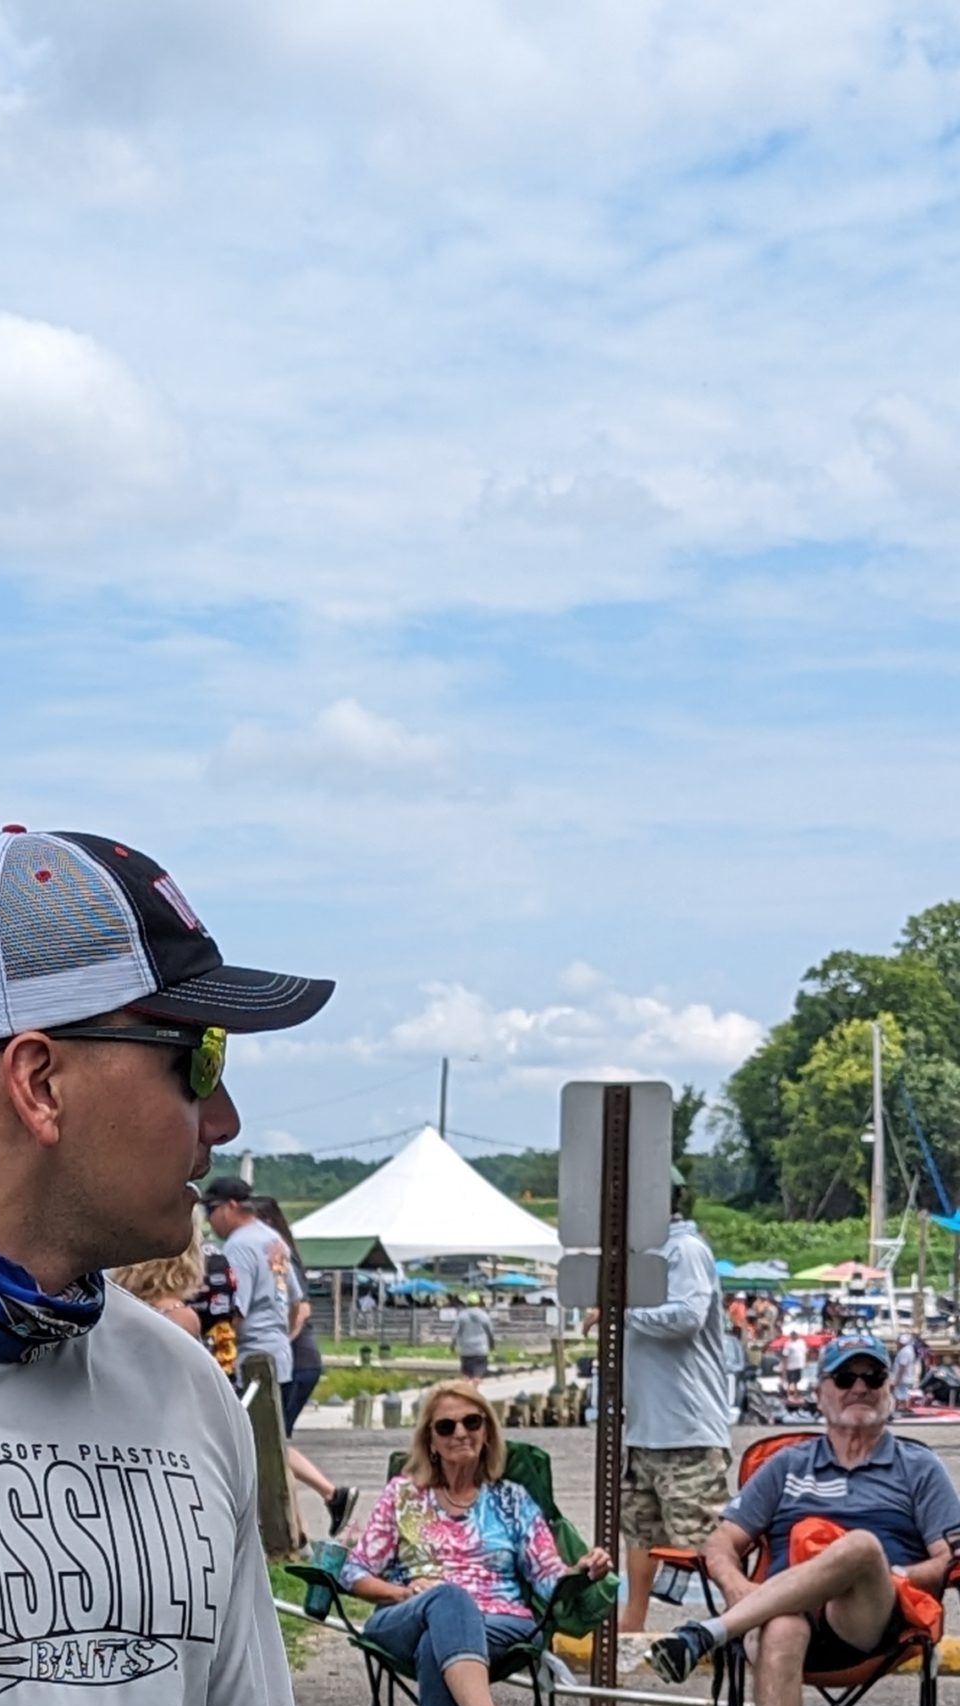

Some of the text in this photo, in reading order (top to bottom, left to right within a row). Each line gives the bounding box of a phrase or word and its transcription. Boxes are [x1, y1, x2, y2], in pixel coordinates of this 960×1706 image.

[0, 1442, 60, 1461] SOFT
[78, 1444, 191, 1470] PLASTICS
[30, 1638, 157, 1680] BAITS
